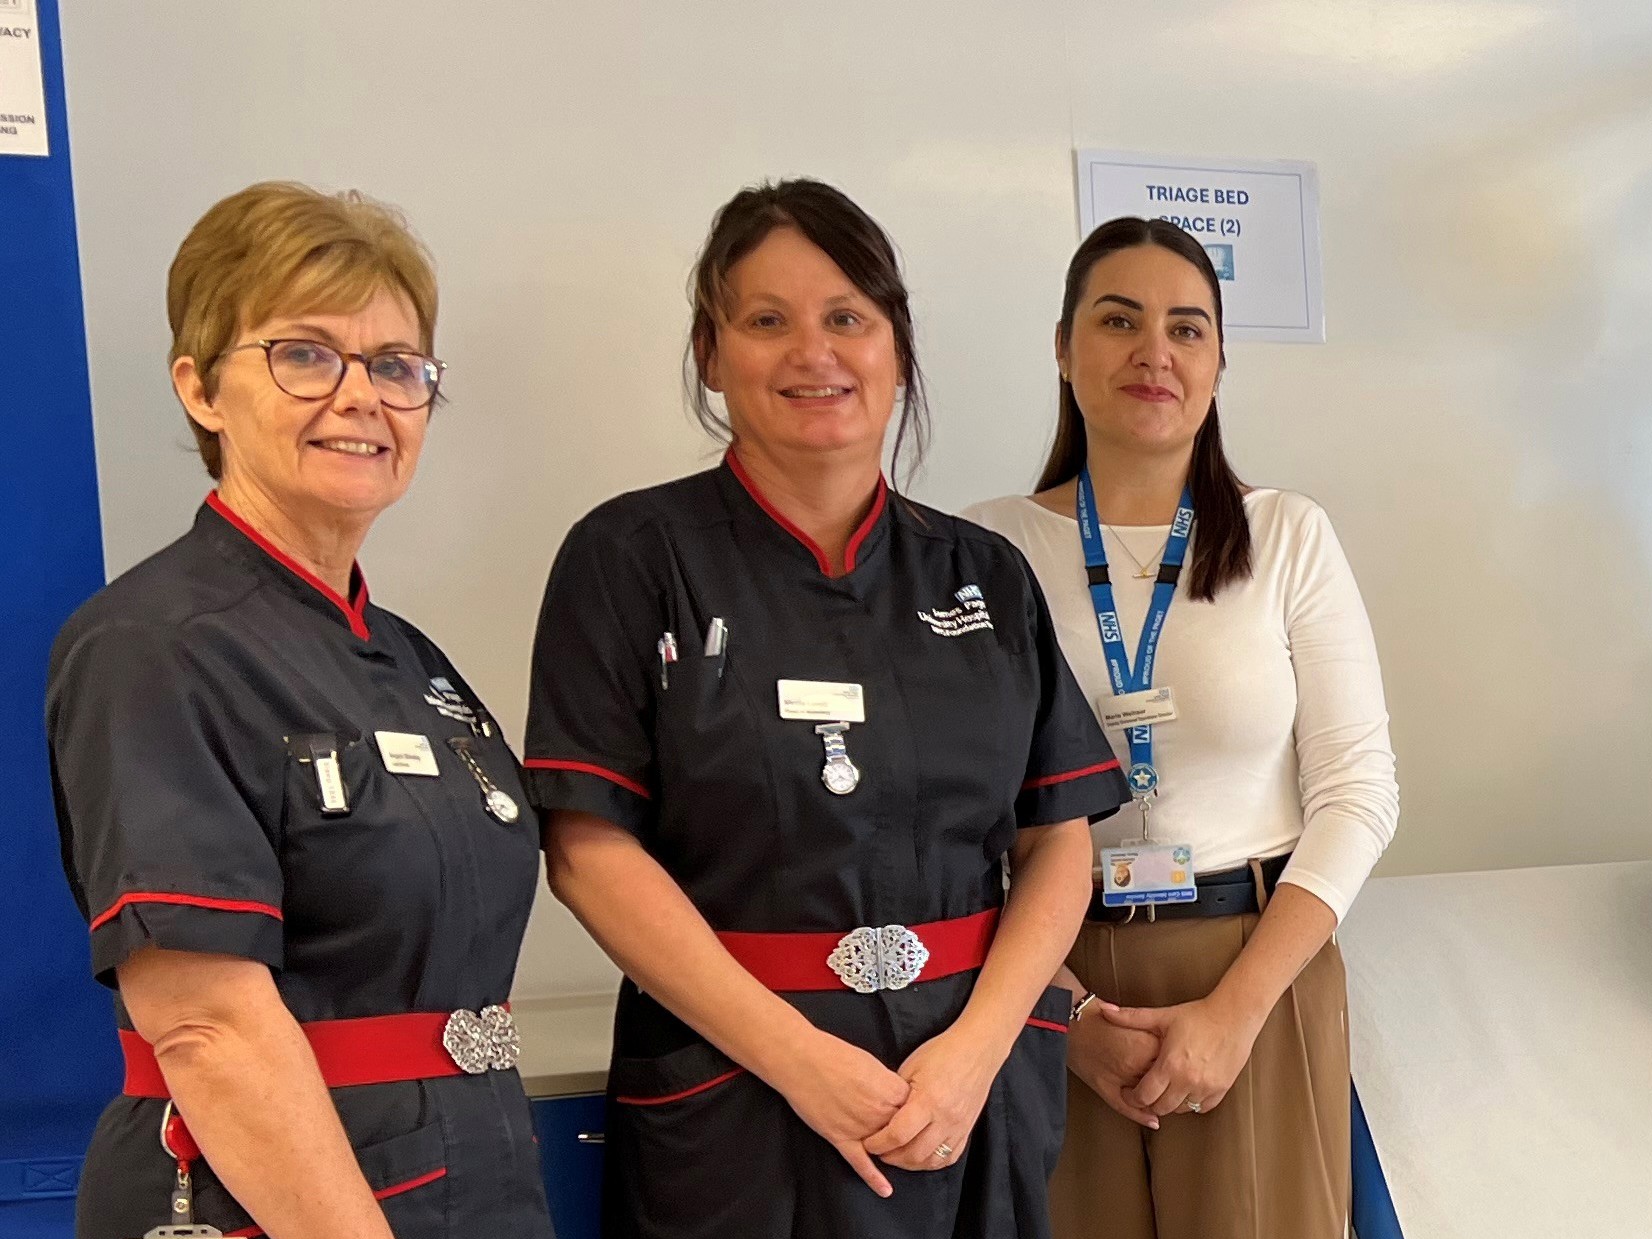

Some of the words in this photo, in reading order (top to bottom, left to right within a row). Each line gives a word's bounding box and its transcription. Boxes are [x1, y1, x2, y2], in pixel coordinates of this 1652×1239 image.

[1146, 185, 1210, 204] TRIAGE
[1214, 188, 1250, 205] BED
[1220, 217, 1242, 238] (2)
[1172, 508, 1194, 538] NHS
[1100, 612, 1120, 641] NHS
